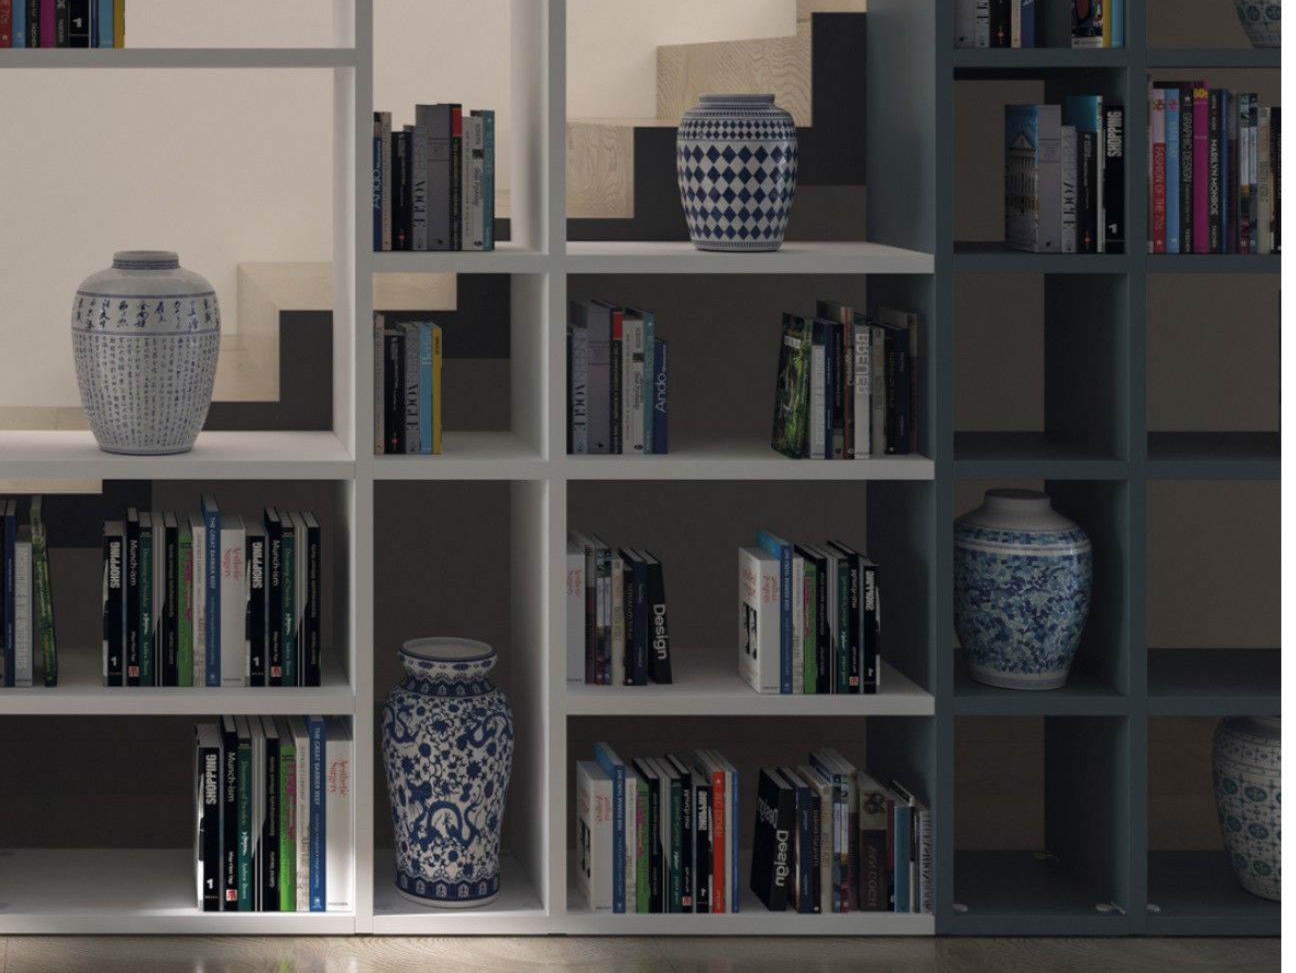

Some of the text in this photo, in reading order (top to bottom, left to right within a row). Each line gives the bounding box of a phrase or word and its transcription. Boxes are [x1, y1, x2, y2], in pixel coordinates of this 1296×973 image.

[655, 372, 667, 412] Ando
[653, 604, 668, 660] Design
[205, 754, 217, 805] SHOPPING
